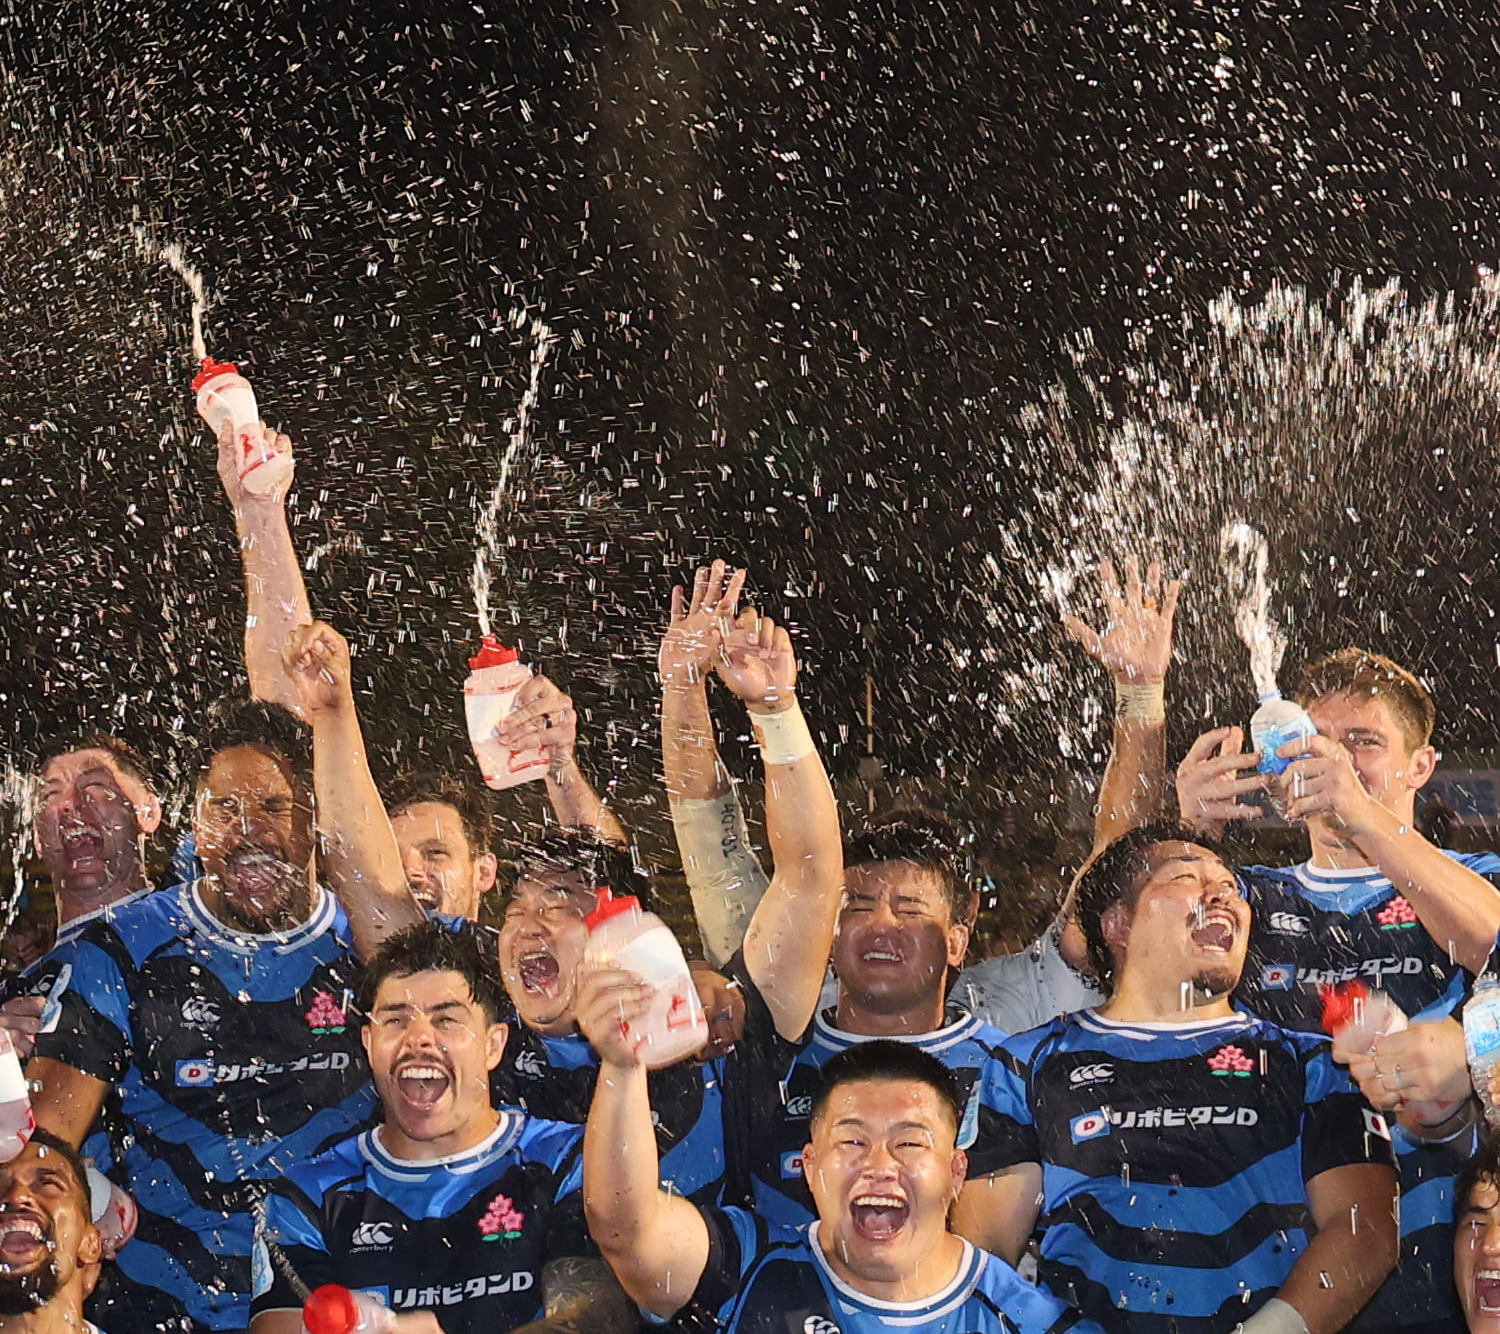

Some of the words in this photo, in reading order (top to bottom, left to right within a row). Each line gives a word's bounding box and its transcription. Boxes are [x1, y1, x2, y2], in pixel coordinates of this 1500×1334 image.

[1297, 957, 1423, 984] リポビタンD
[1069, 1078, 1115, 1091] canterbury
[1112, 1106, 1258, 1129] リポビタンD
[349, 1245, 395, 1254] canterbury
[393, 1271, 534, 1308] リポビタンD
